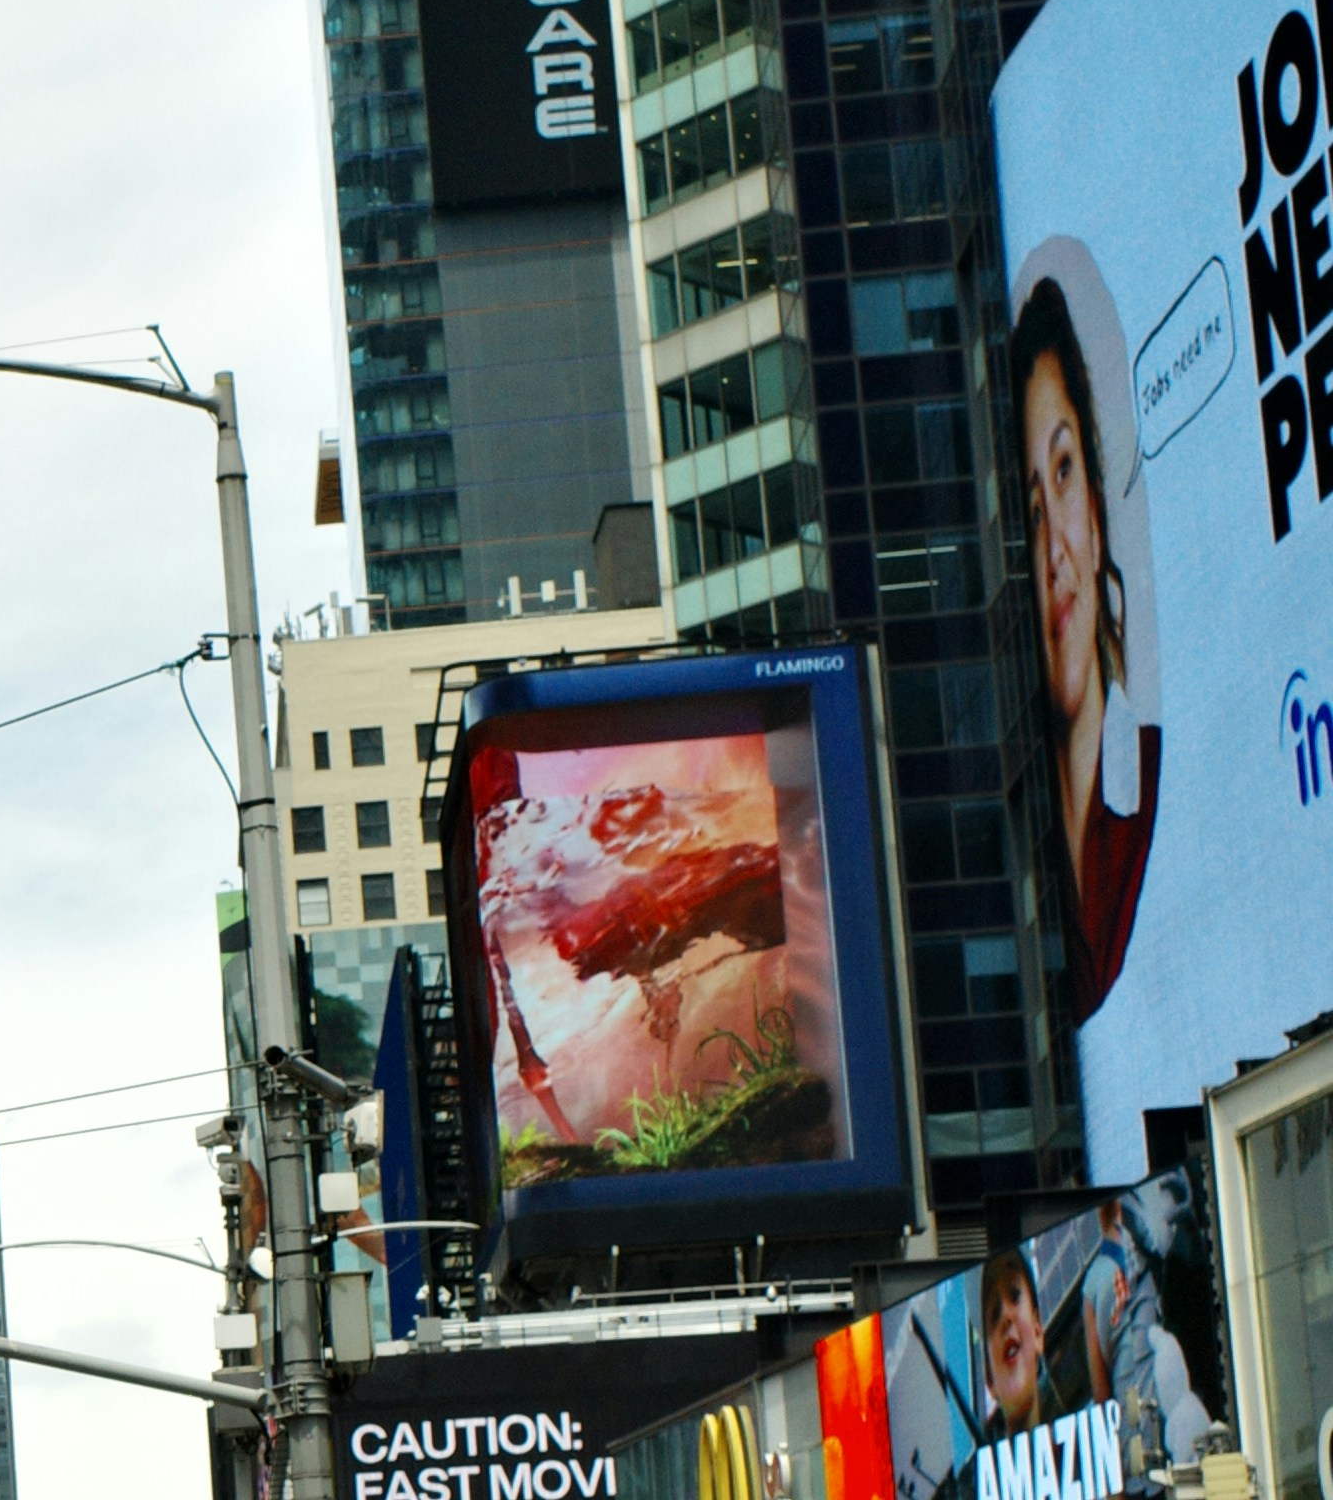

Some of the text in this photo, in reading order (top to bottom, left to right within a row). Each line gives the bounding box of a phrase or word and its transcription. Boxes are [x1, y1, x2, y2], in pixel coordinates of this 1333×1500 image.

[755, 654, 845, 678] FLAMINGO
[350, 1411, 584, 1465] CAUTION:
[488, 1454, 618, 1500] MOVI
